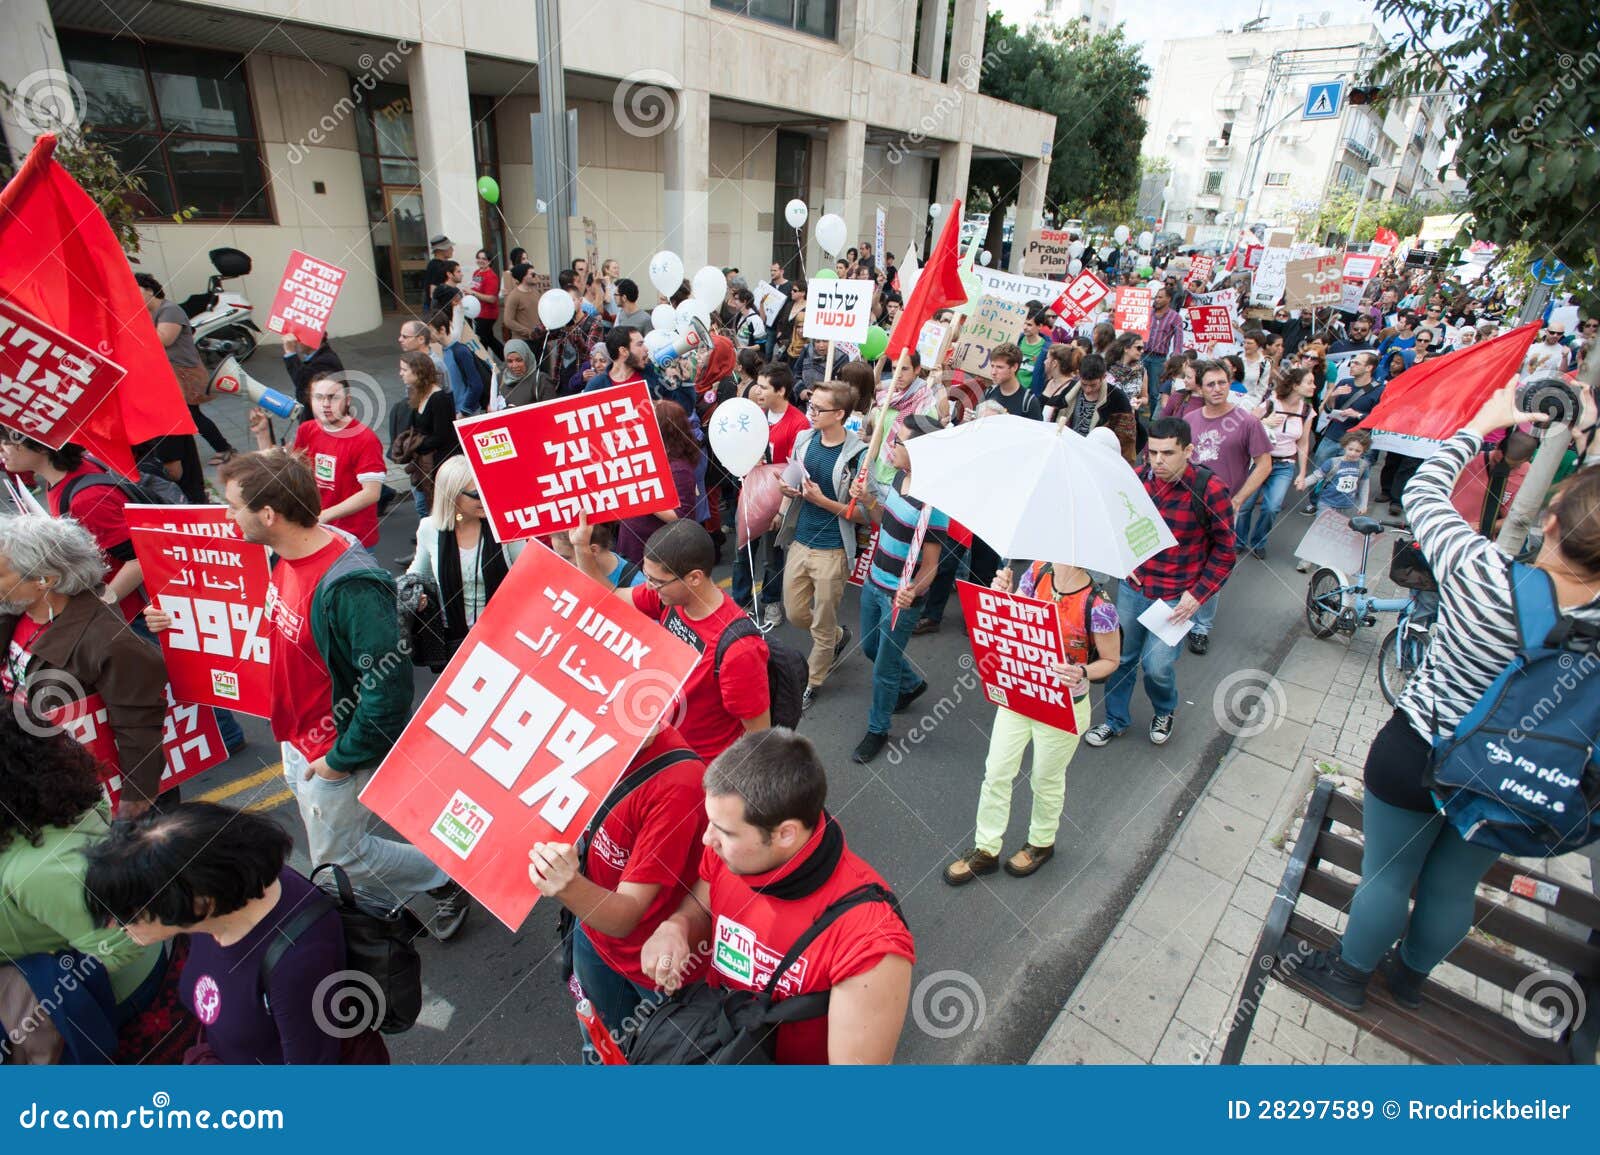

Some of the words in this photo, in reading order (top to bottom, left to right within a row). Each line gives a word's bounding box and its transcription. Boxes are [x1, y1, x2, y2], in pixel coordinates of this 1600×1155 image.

[1030, 241, 1068, 254] Prawer
[1041, 230, 1069, 244] Stop
[1040, 255, 1066, 265] Plan
[817, 282, 859, 311] שלום
[1068, 275, 1107, 308] 67
[815, 311, 856, 327] עכשיו
[554, 397, 640, 434] ביחד
[543, 437, 591, 467] על
[601, 424, 649, 458] נגן
[536, 450, 657, 498] המרחב
[504, 477, 665, 530] הדמוקרטי
[192, 548, 244, 568] אנחנו
[978, 592, 1050, 625] יהודים
[157, 594, 271, 665] 99%
[576, 606, 653, 669] אנחנו
[976, 610, 1056, 649] וערבים
[973, 628, 1059, 668] מסרבים
[1000, 654, 1062, 688] להיות
[995, 670, 1067, 708] אויבים
[425, 640, 618, 833] 99%
